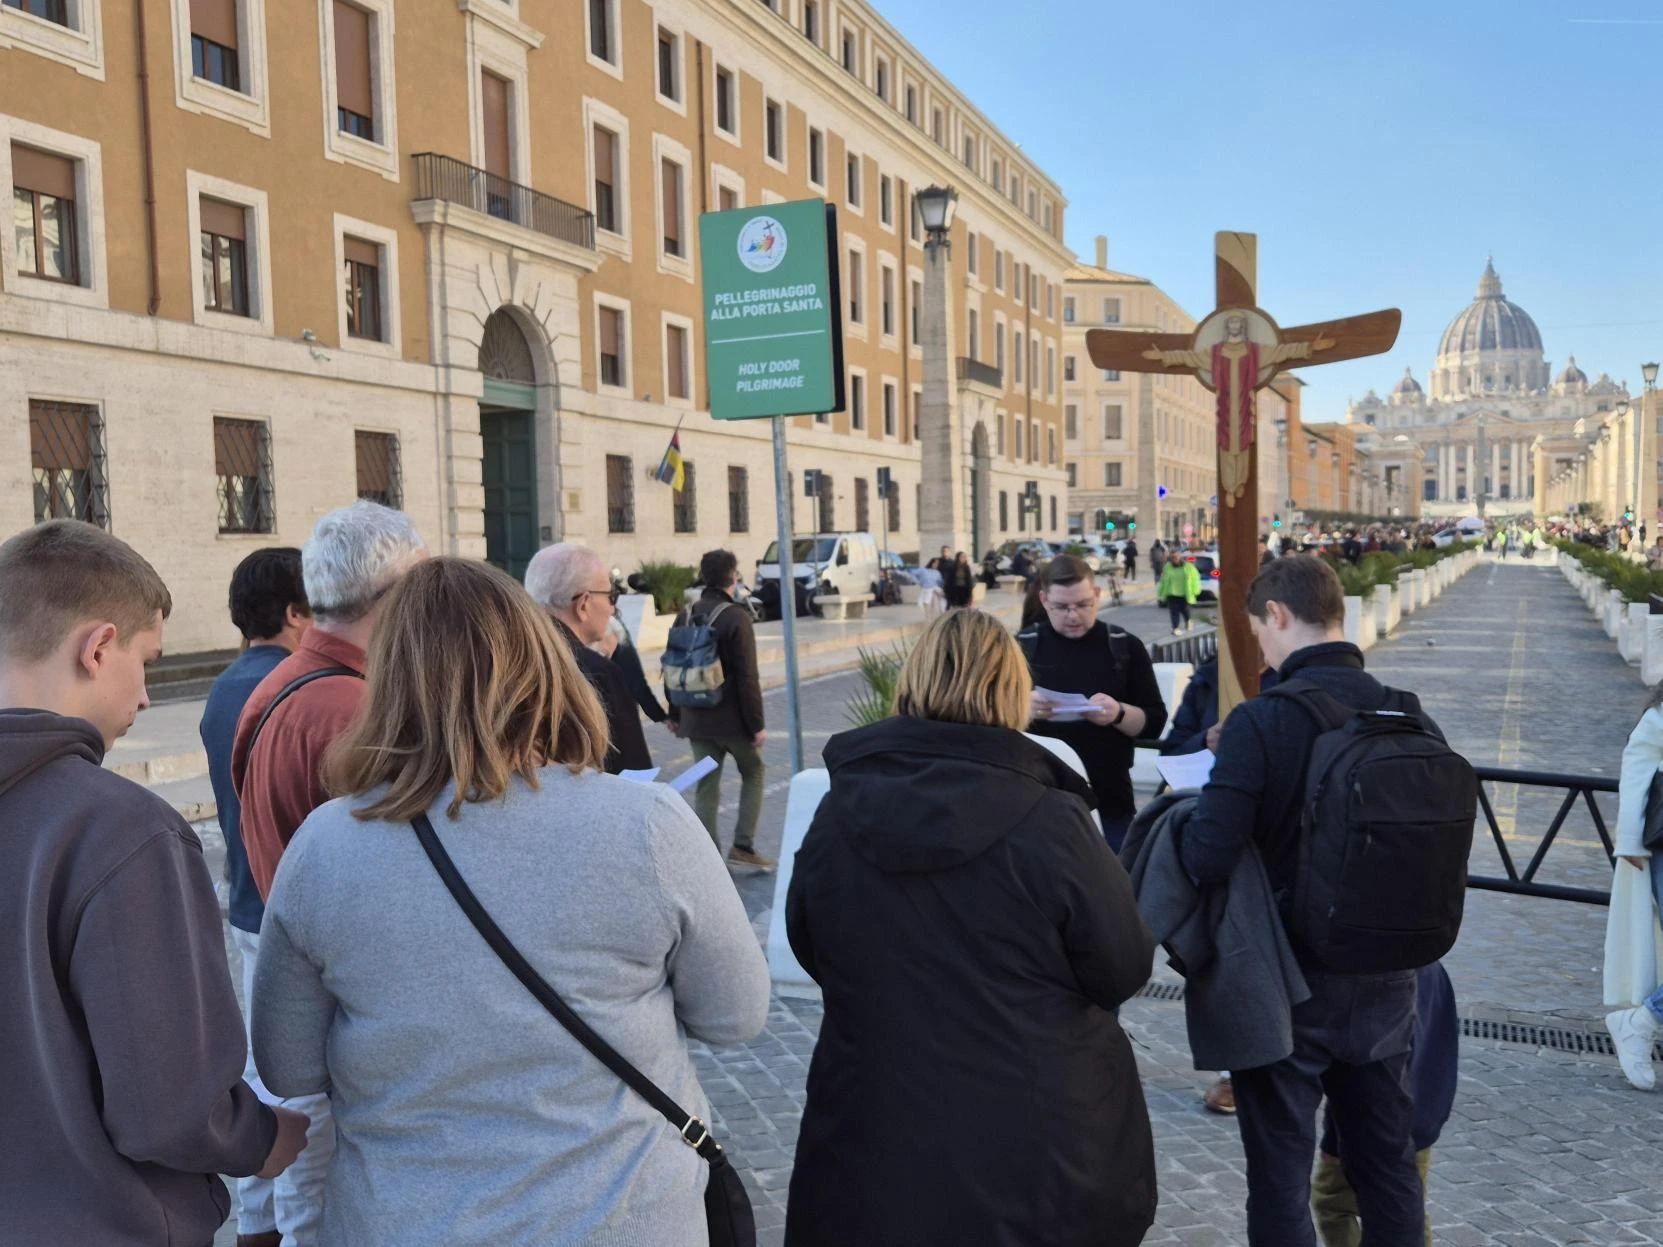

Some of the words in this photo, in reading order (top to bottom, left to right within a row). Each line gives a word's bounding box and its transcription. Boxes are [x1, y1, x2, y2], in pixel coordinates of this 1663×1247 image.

[715, 284, 816, 305] PELLEGRINAGGIO
[711, 306, 741, 320] ALLA
[743, 302, 781, 317] PORTA
[783, 297, 822, 312] SANTA
[739, 361, 767, 375] HOLY
[769, 359, 800, 373] DOOR
[736, 376, 804, 392] PILGRIMAGE
